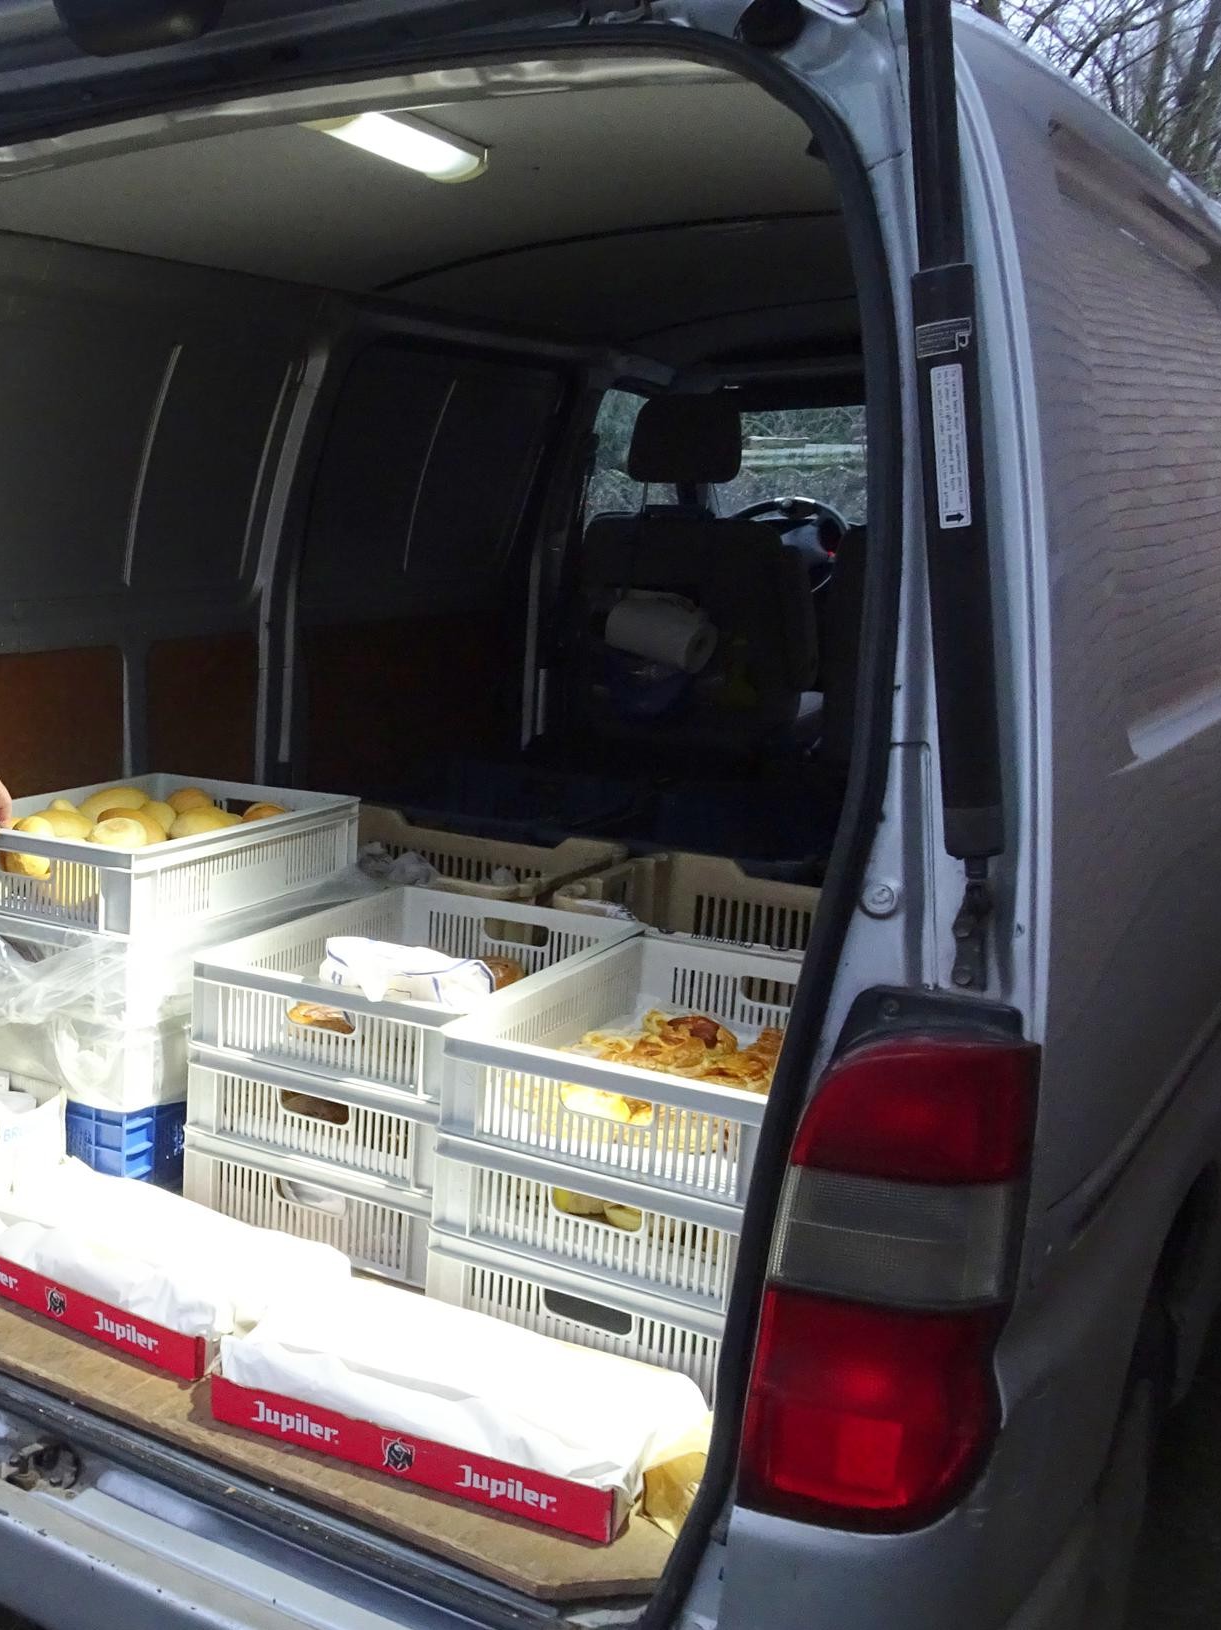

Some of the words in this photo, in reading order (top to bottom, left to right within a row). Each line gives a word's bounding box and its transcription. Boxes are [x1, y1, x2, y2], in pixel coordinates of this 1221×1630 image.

[93, 1311, 159, 1352] Jupiler
[251, 1400, 340, 1444] Jupiler
[455, 1464, 557, 1512] Jupiler
